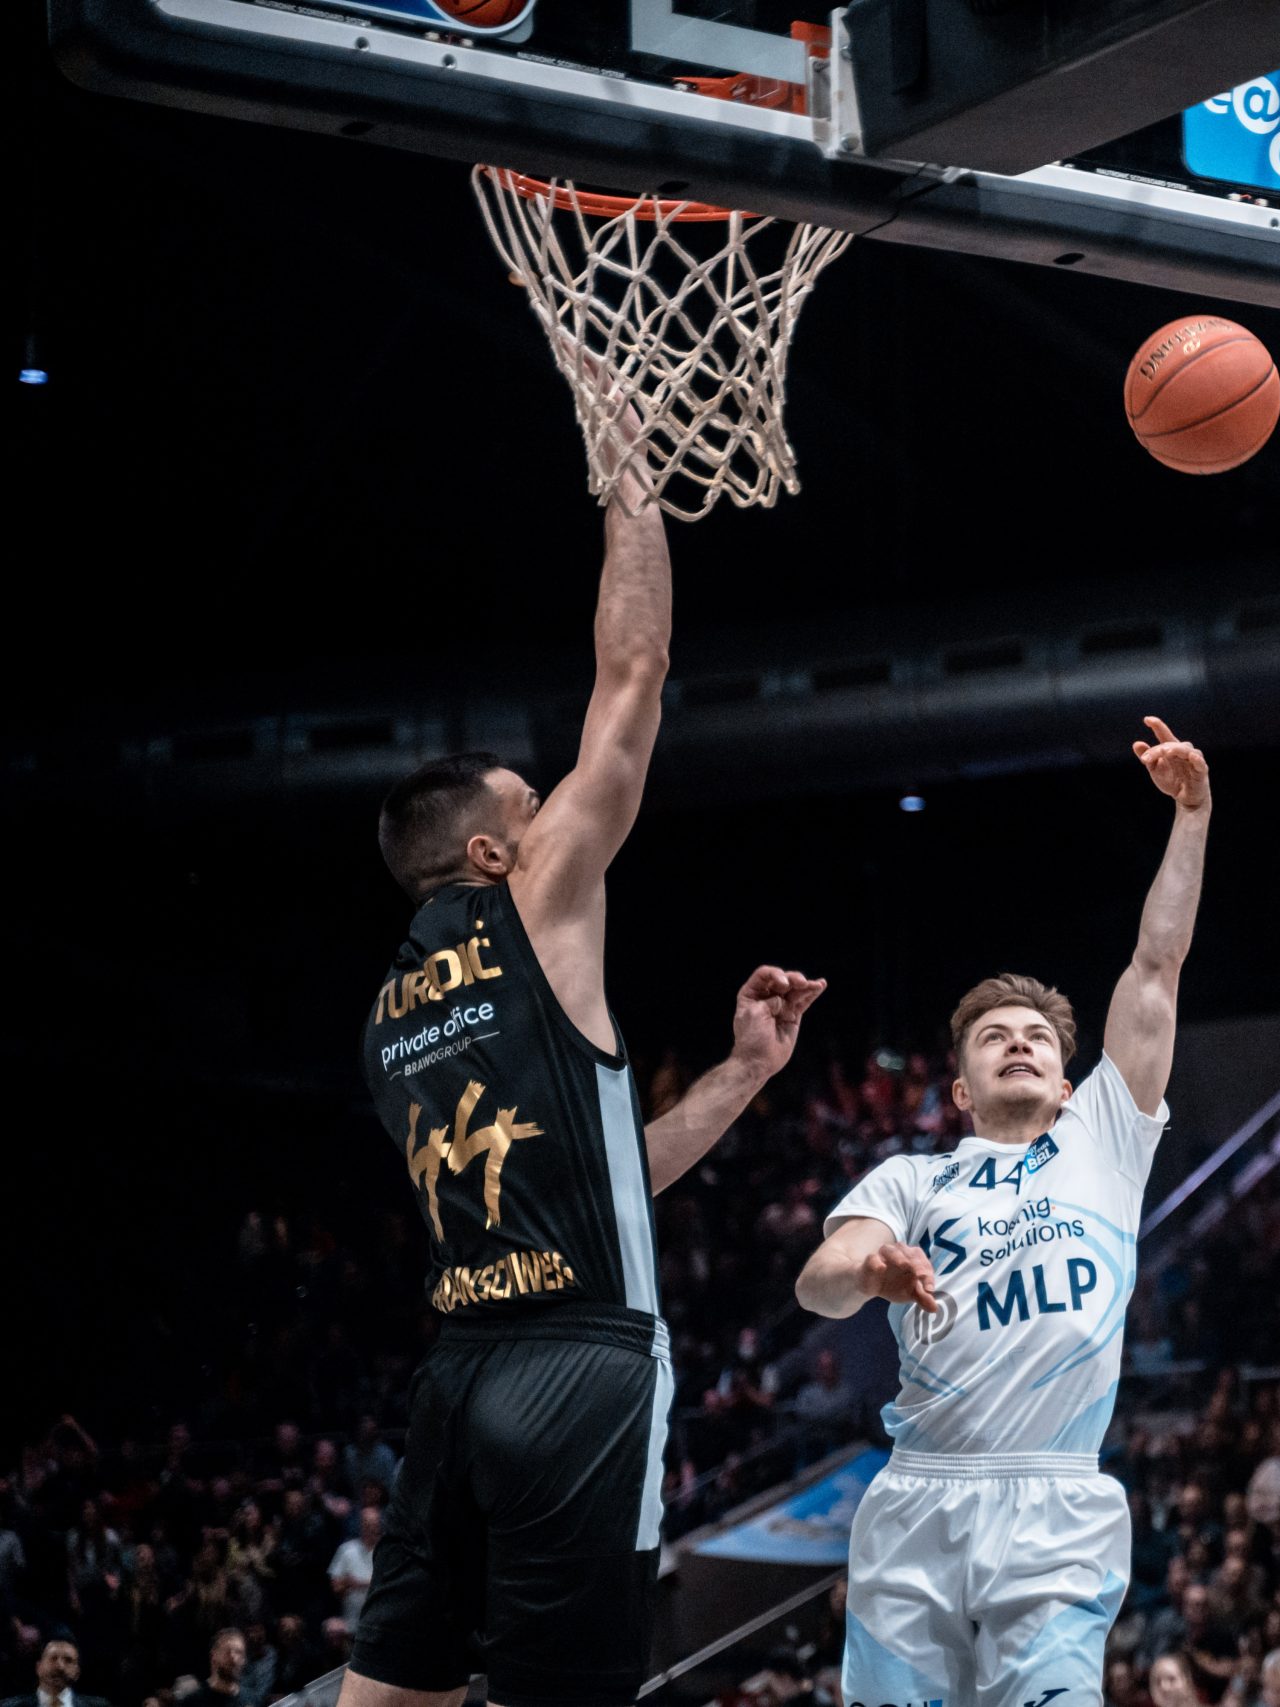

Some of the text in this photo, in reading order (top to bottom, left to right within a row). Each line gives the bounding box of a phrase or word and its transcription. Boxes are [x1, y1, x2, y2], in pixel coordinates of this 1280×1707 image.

[381, 1026, 440, 1072] private
[404, 1036, 472, 1076] BRAWOGROUP
[407, 1079, 545, 1243] 44
[1027, 1148, 1056, 1170] BBL
[976, 1257, 1097, 1331] MLP
